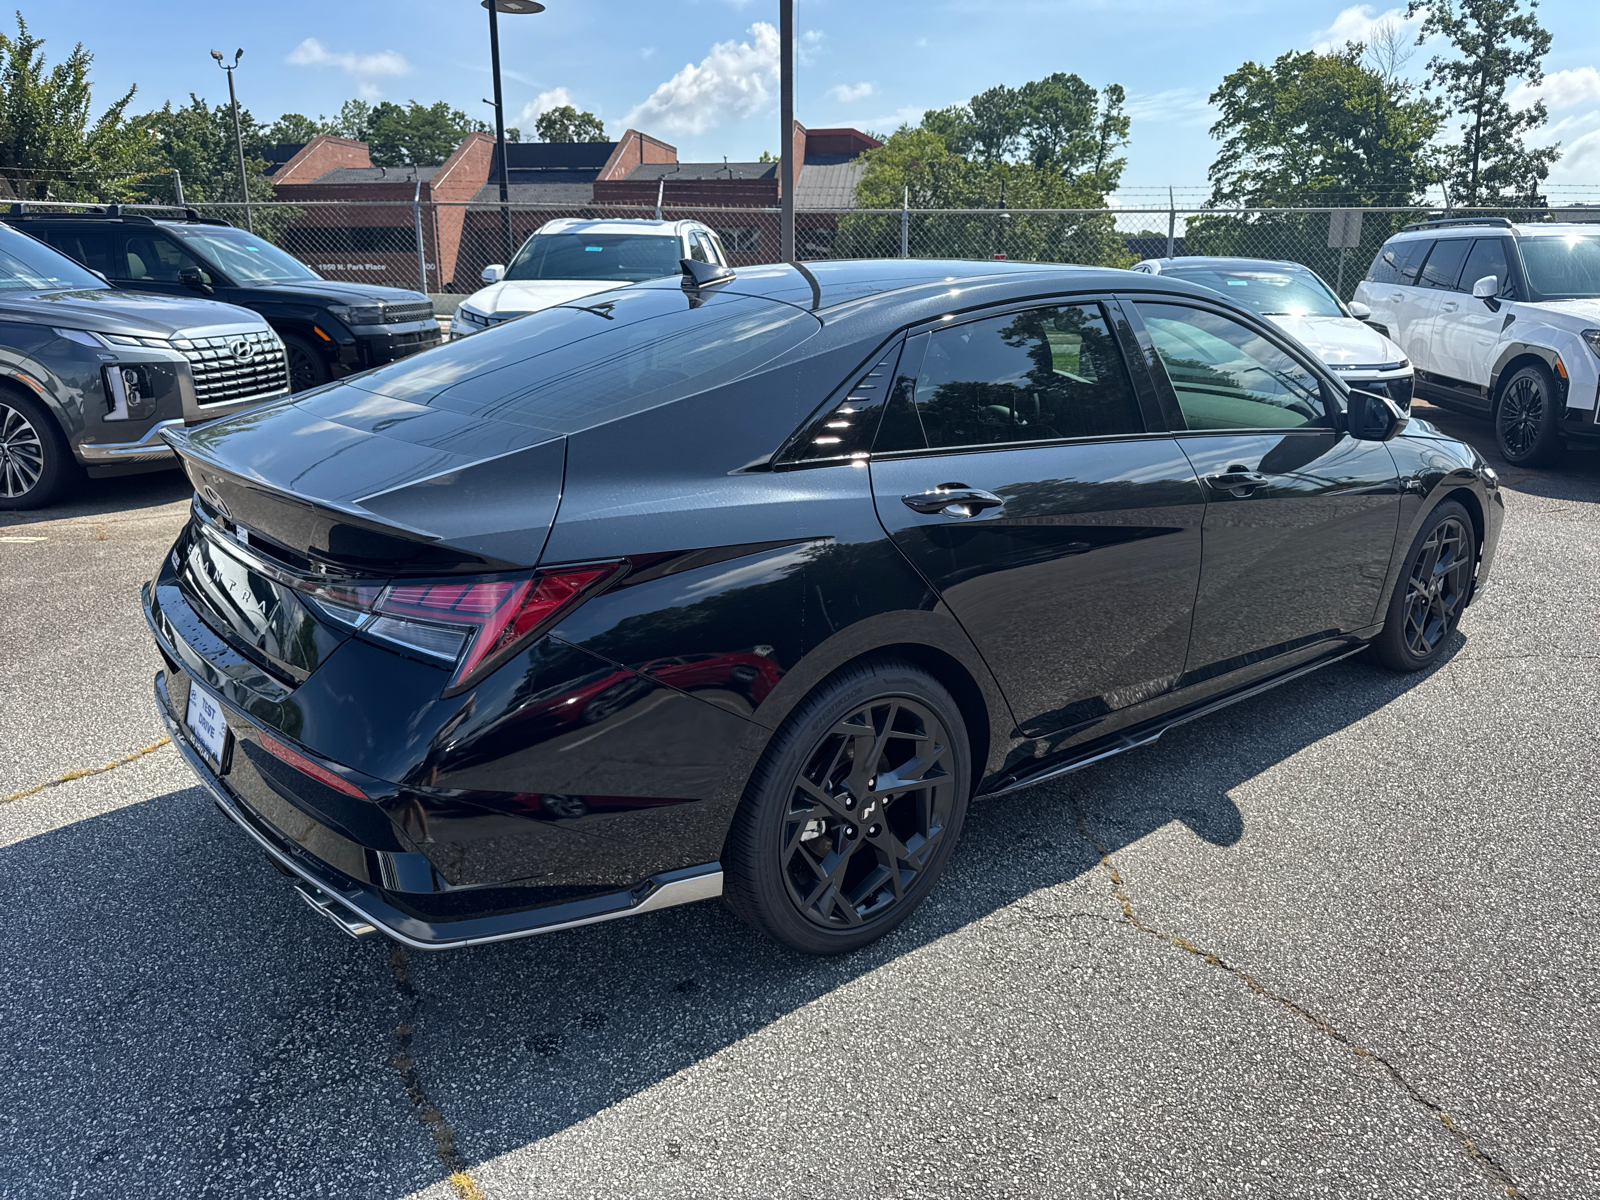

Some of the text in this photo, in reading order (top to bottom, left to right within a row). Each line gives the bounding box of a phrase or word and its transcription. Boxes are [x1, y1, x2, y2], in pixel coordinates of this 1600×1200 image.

[347, 263, 364, 271] Park
[365, 263, 387, 271] Place
[186, 543, 267, 614] ELANTRA
[202, 697, 216, 720] TEST
[198, 712, 216, 739] DRIVE
